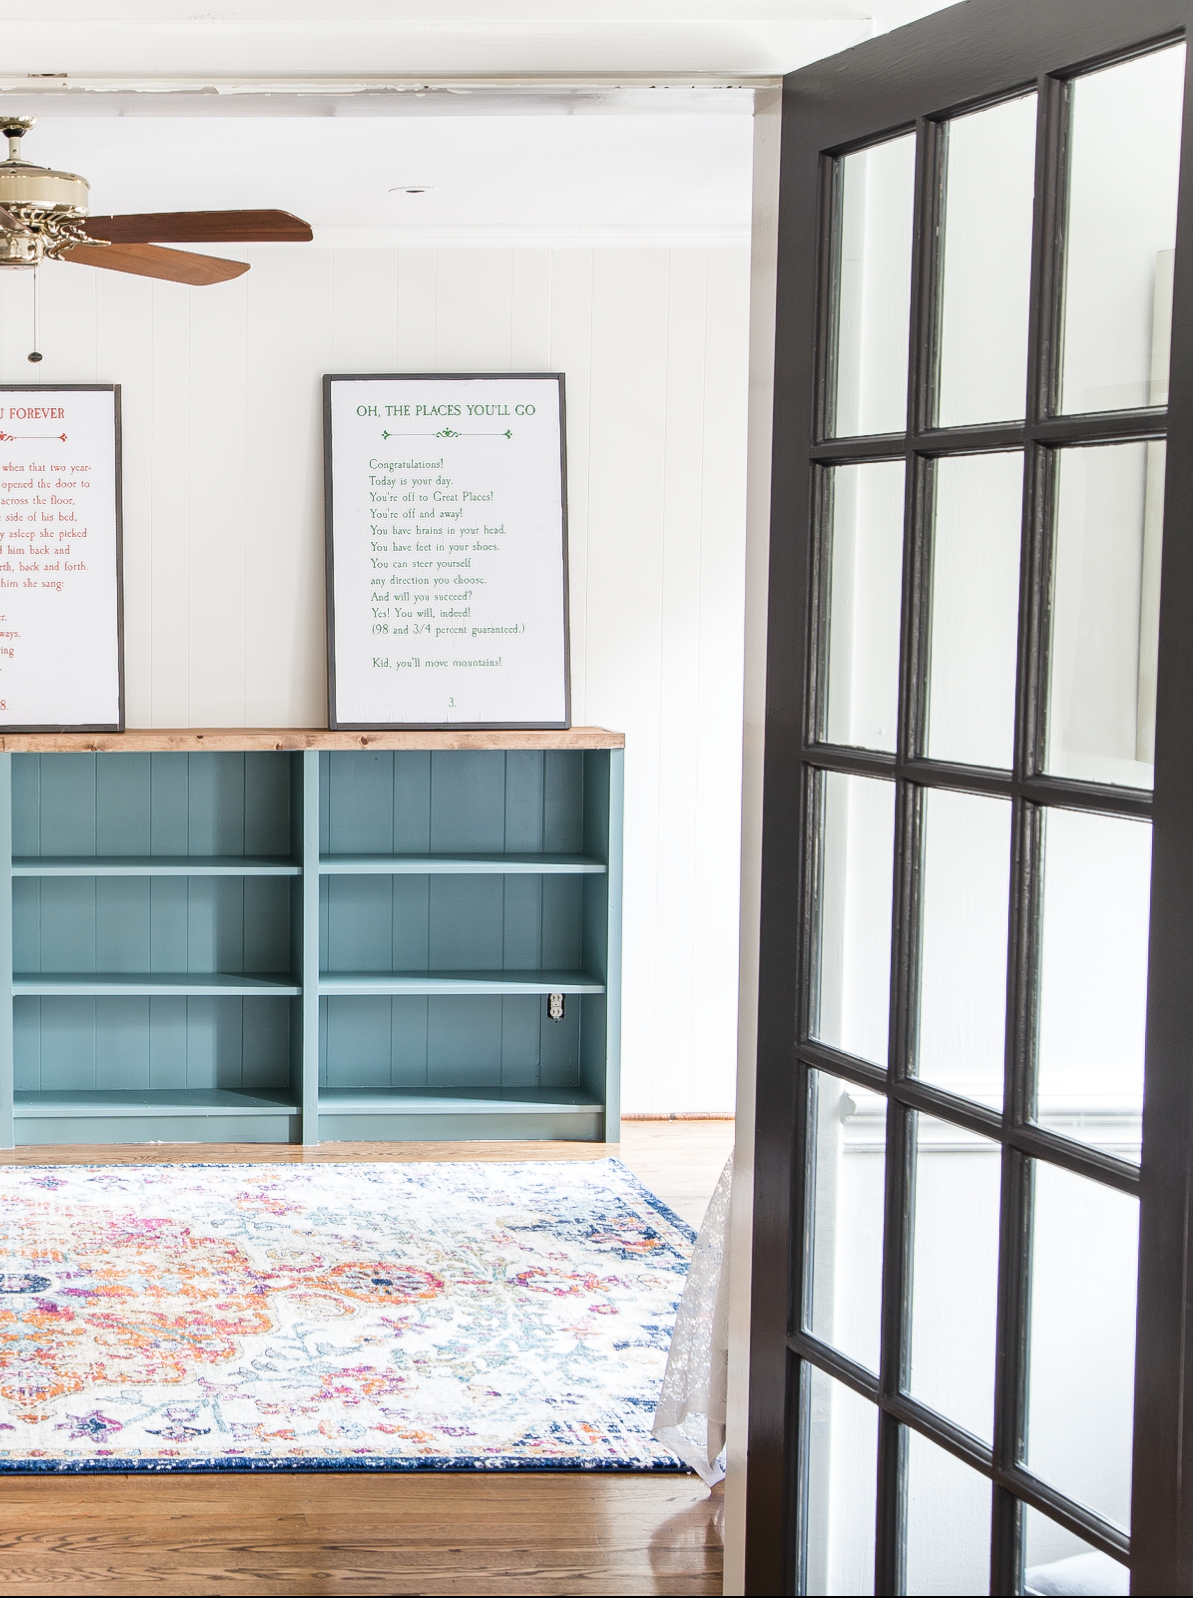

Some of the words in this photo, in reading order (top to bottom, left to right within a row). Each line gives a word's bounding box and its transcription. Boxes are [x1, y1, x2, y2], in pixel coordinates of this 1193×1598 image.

[8, 407, 65, 420] FOREVER
[356, 404, 381, 418] OH,
[384, 404, 411, 417] THE
[415, 404, 462, 417] PLACES
[465, 404, 512, 416] YOU'LL
[514, 404, 536, 416] GO
[1, 461, 25, 472] when
[28, 461, 46, 472] that
[50, 464, 67, 472] two
[69, 465, 92, 476] year-
[368, 457, 444, 474] Congratulations!
[368, 475, 397, 490] Today
[400, 477, 408, 486] is
[411, 478, 433, 489] your
[435, 474, 454, 489] day.
[0, 498, 29, 506] across
[32, 494, 47, 505] the
[50, 494, 75, 506] floor,
[369, 491, 399, 503] You're
[401, 491, 416, 502] off
[418, 494, 429, 502] to
[432, 490, 459, 502] Great
[462, 490, 494, 502] Places!
[369, 507, 399, 519] You're
[402, 507, 416, 519] off
[419, 507, 436, 519] and
[439, 507, 463, 522] away!
[369, 524, 388, 536] You
[392, 524, 412, 536] have
[415, 524, 444, 536] brains
[447, 525, 456, 535] in
[459, 527, 480, 538] your
[6, 544, 26, 555] him
[28, 544, 50, 555] back
[53, 544, 70, 555] and
[370, 541, 388, 552] You
[392, 541, 412, 552] have
[415, 541, 432, 552] feet
[436, 544, 445, 552] in
[448, 544, 469, 555] your
[471, 540, 500, 552] shoes.
[369, 557, 389, 569] You
[392, 561, 408, 569] can
[412, 560, 434, 568] steer
[436, 557, 472, 572] yourself
[0, 577, 19, 588] him
[22, 577, 38, 588] she
[370, 578, 386, 589] any
[389, 574, 430, 585] direction
[433, 577, 450, 588] you
[452, 573, 487, 585] choose.
[370, 591, 390, 602] And
[393, 591, 410, 602] will
[413, 594, 430, 605] you
[434, 589, 473, 602] succeed?
[370, 607, 390, 619] Yes!
[394, 607, 413, 618] You
[439, 606, 471, 618] indeed!
[371, 623, 389, 636] (98
[392, 624, 409, 635] and
[412, 623, 431, 635] 3/4
[435, 626, 468, 638] percent
[372, 657, 392, 669] Kid,
[424, 660, 449, 668] move
[452, 656, 502, 667] mountains!
[0, 699, 10, 712] 8.
[448, 696, 457, 708] 3.
